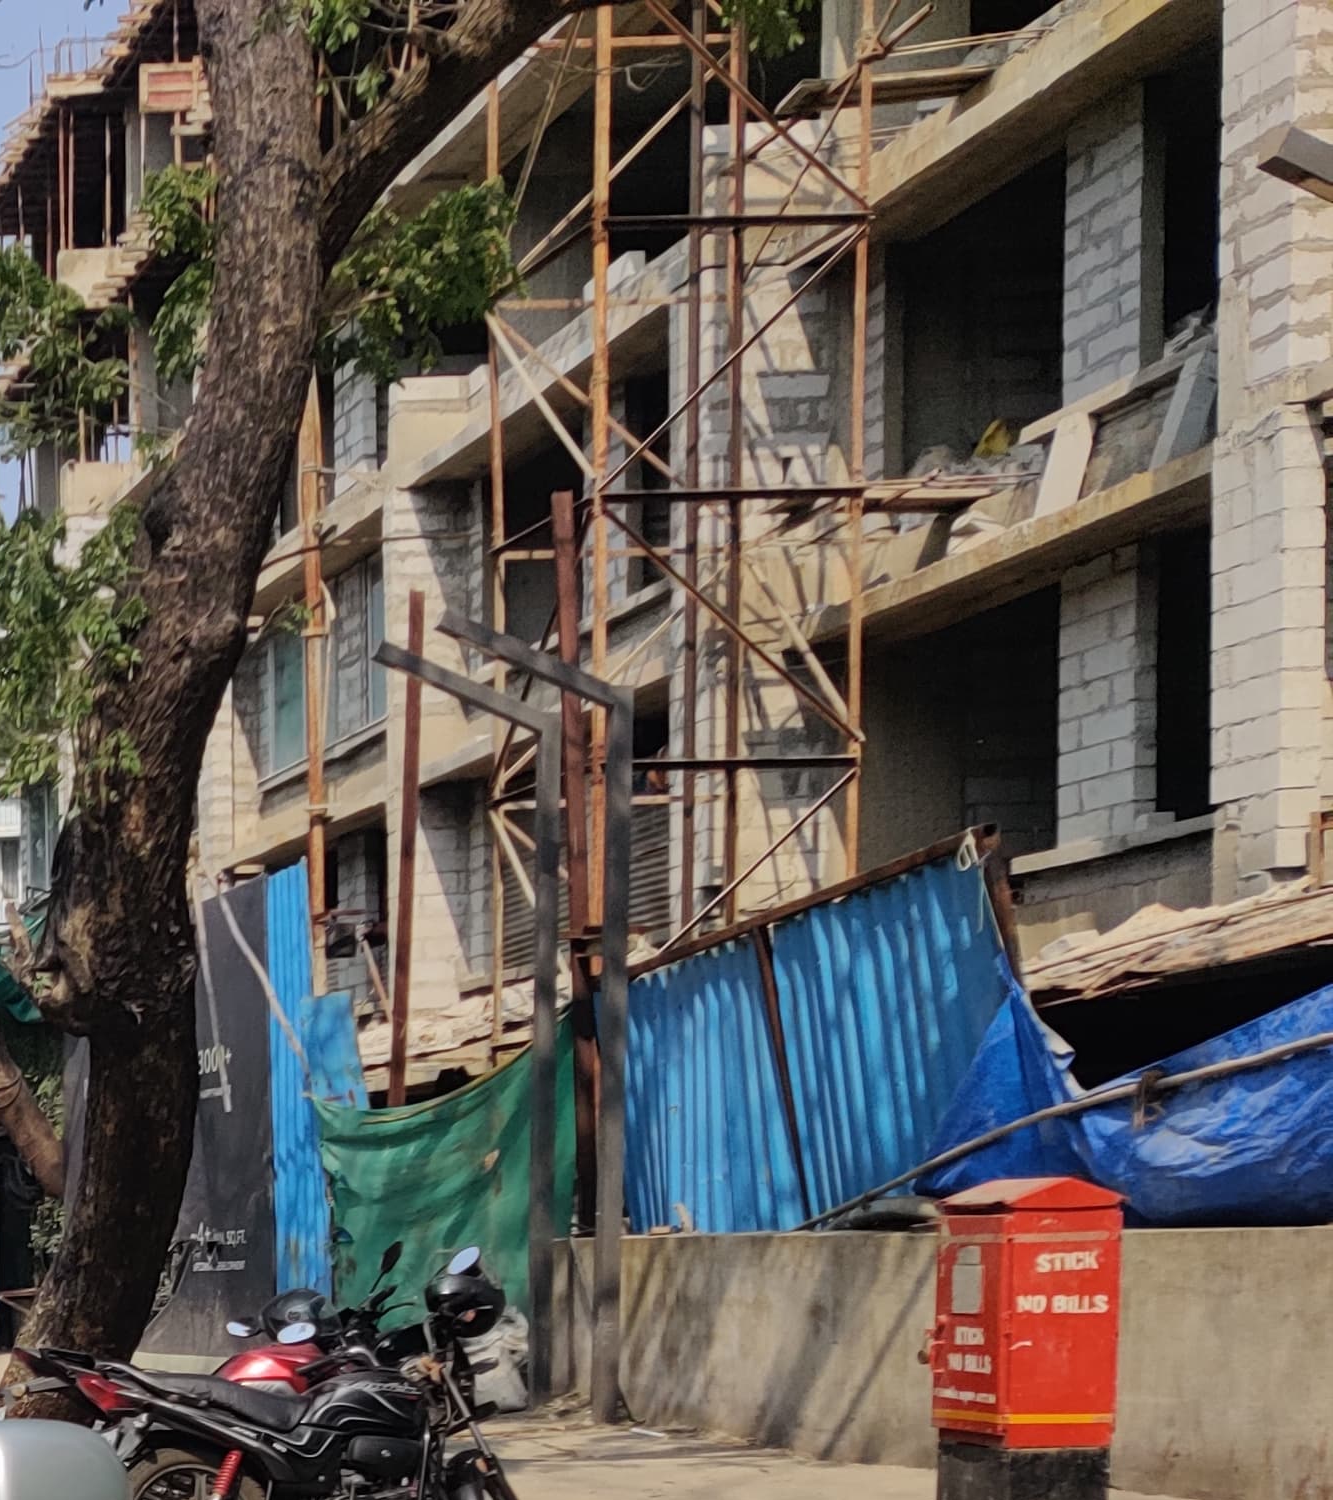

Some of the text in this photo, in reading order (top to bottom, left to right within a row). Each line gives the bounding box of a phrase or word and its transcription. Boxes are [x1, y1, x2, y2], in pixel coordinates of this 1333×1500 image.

[1036, 1249, 1100, 1273] STICK
[1016, 1294, 1110, 1314] NO BILLS
